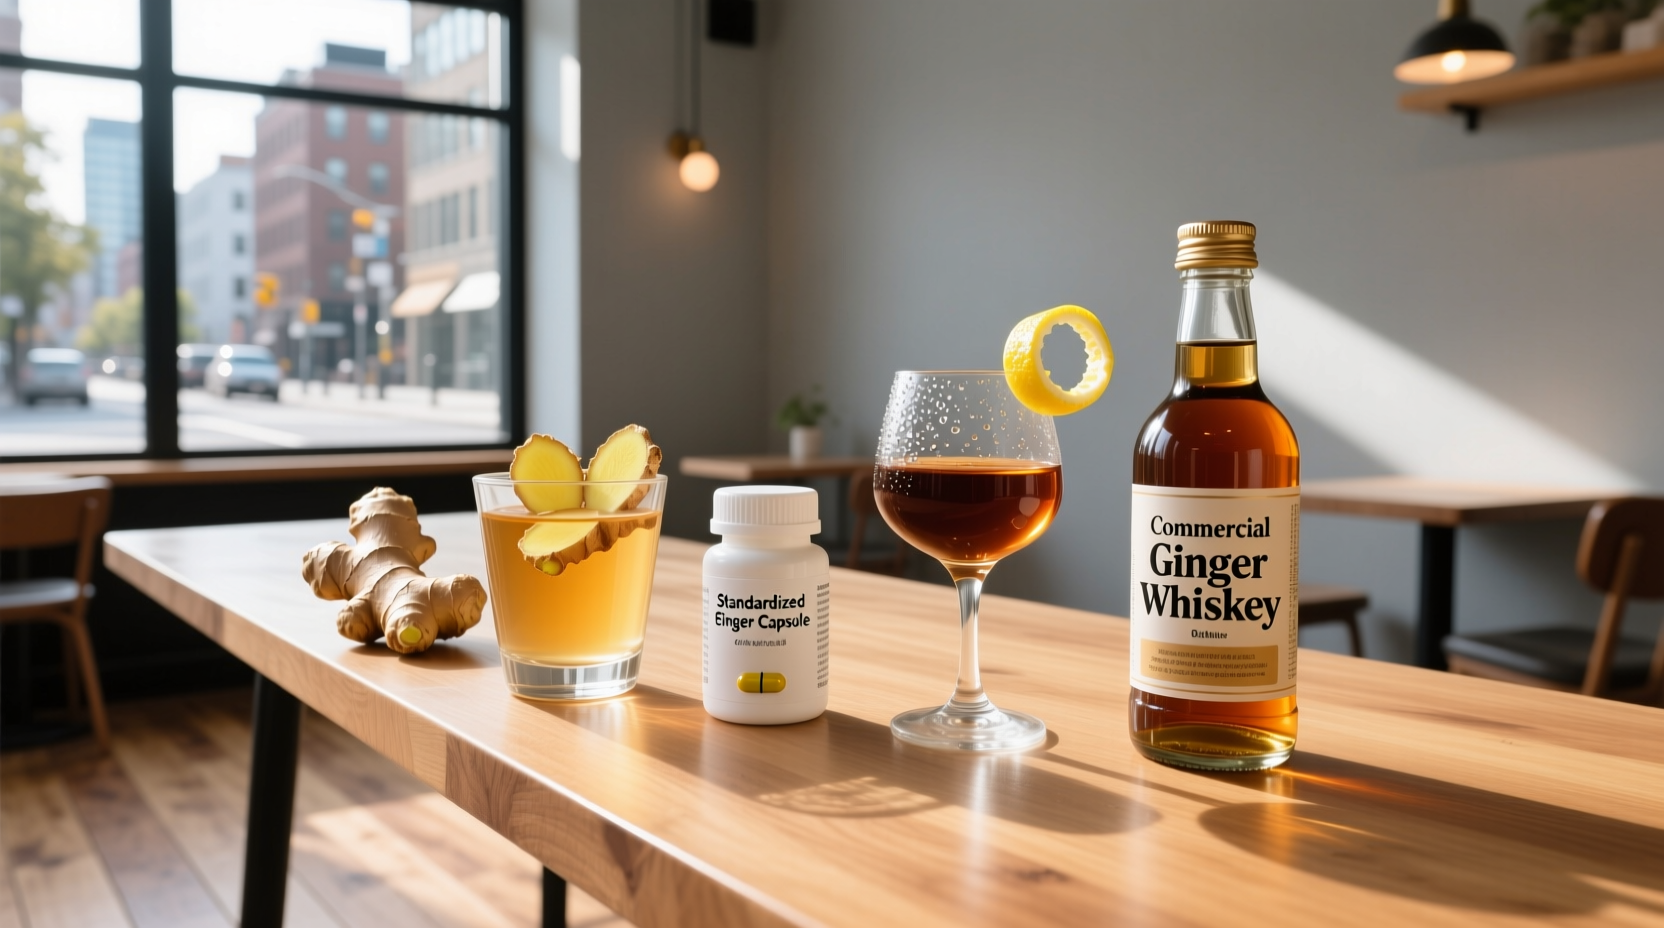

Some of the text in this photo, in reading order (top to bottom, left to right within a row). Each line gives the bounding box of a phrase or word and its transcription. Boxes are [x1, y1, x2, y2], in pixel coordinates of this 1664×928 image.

[1150, 515, 1271, 538] Commercial
[1150, 542, 1268, 588] Ginger
[717, 593, 805, 609] Standardized
[1140, 582, 1281, 630] Whiskey
[758, 612, 811, 632] Capsule
